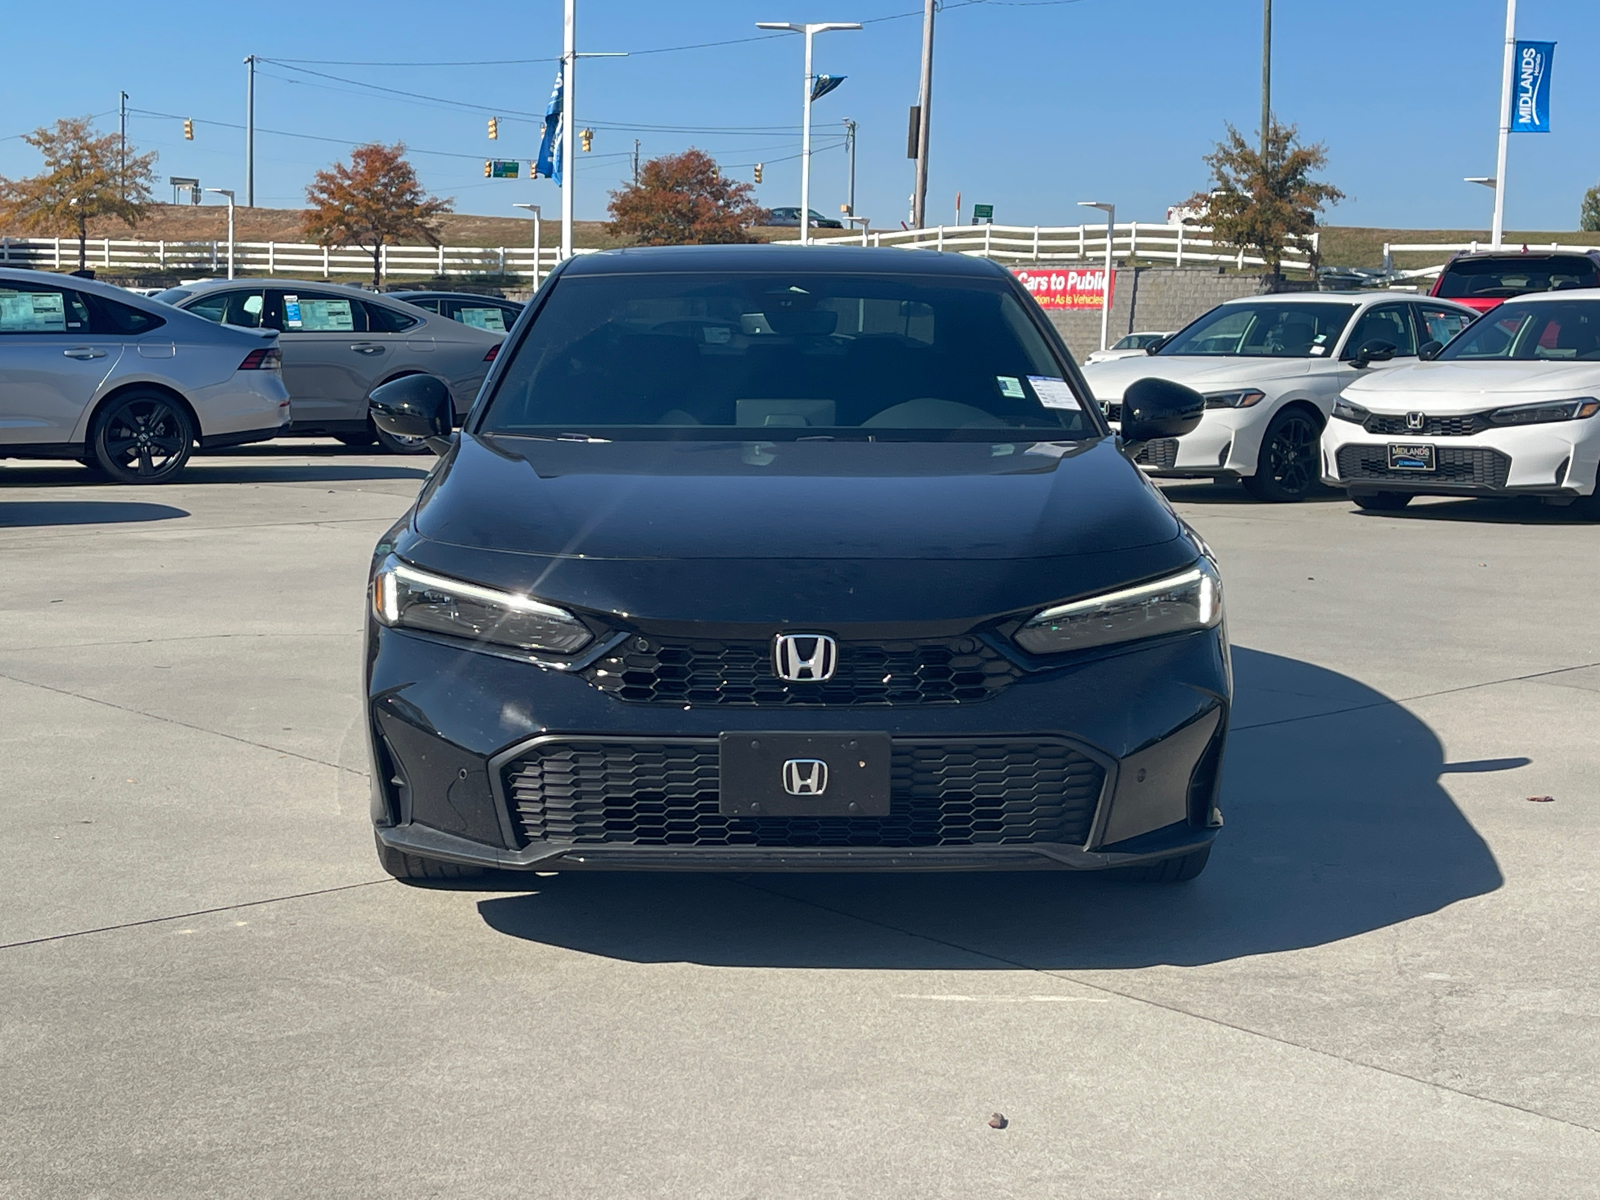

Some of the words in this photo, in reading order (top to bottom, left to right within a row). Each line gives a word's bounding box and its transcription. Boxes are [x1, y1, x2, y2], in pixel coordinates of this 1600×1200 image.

[1533, 53, 1541, 76] Honda
[1518, 48, 1536, 124] MIDLANDS
[1017, 271, 1049, 291] Cars
[1050, 272, 1066, 291] to
[1054, 293, 1065, 304] As
[1073, 293, 1104, 305] Vehicles
[1392, 447, 1430, 456] MIDLANDS
